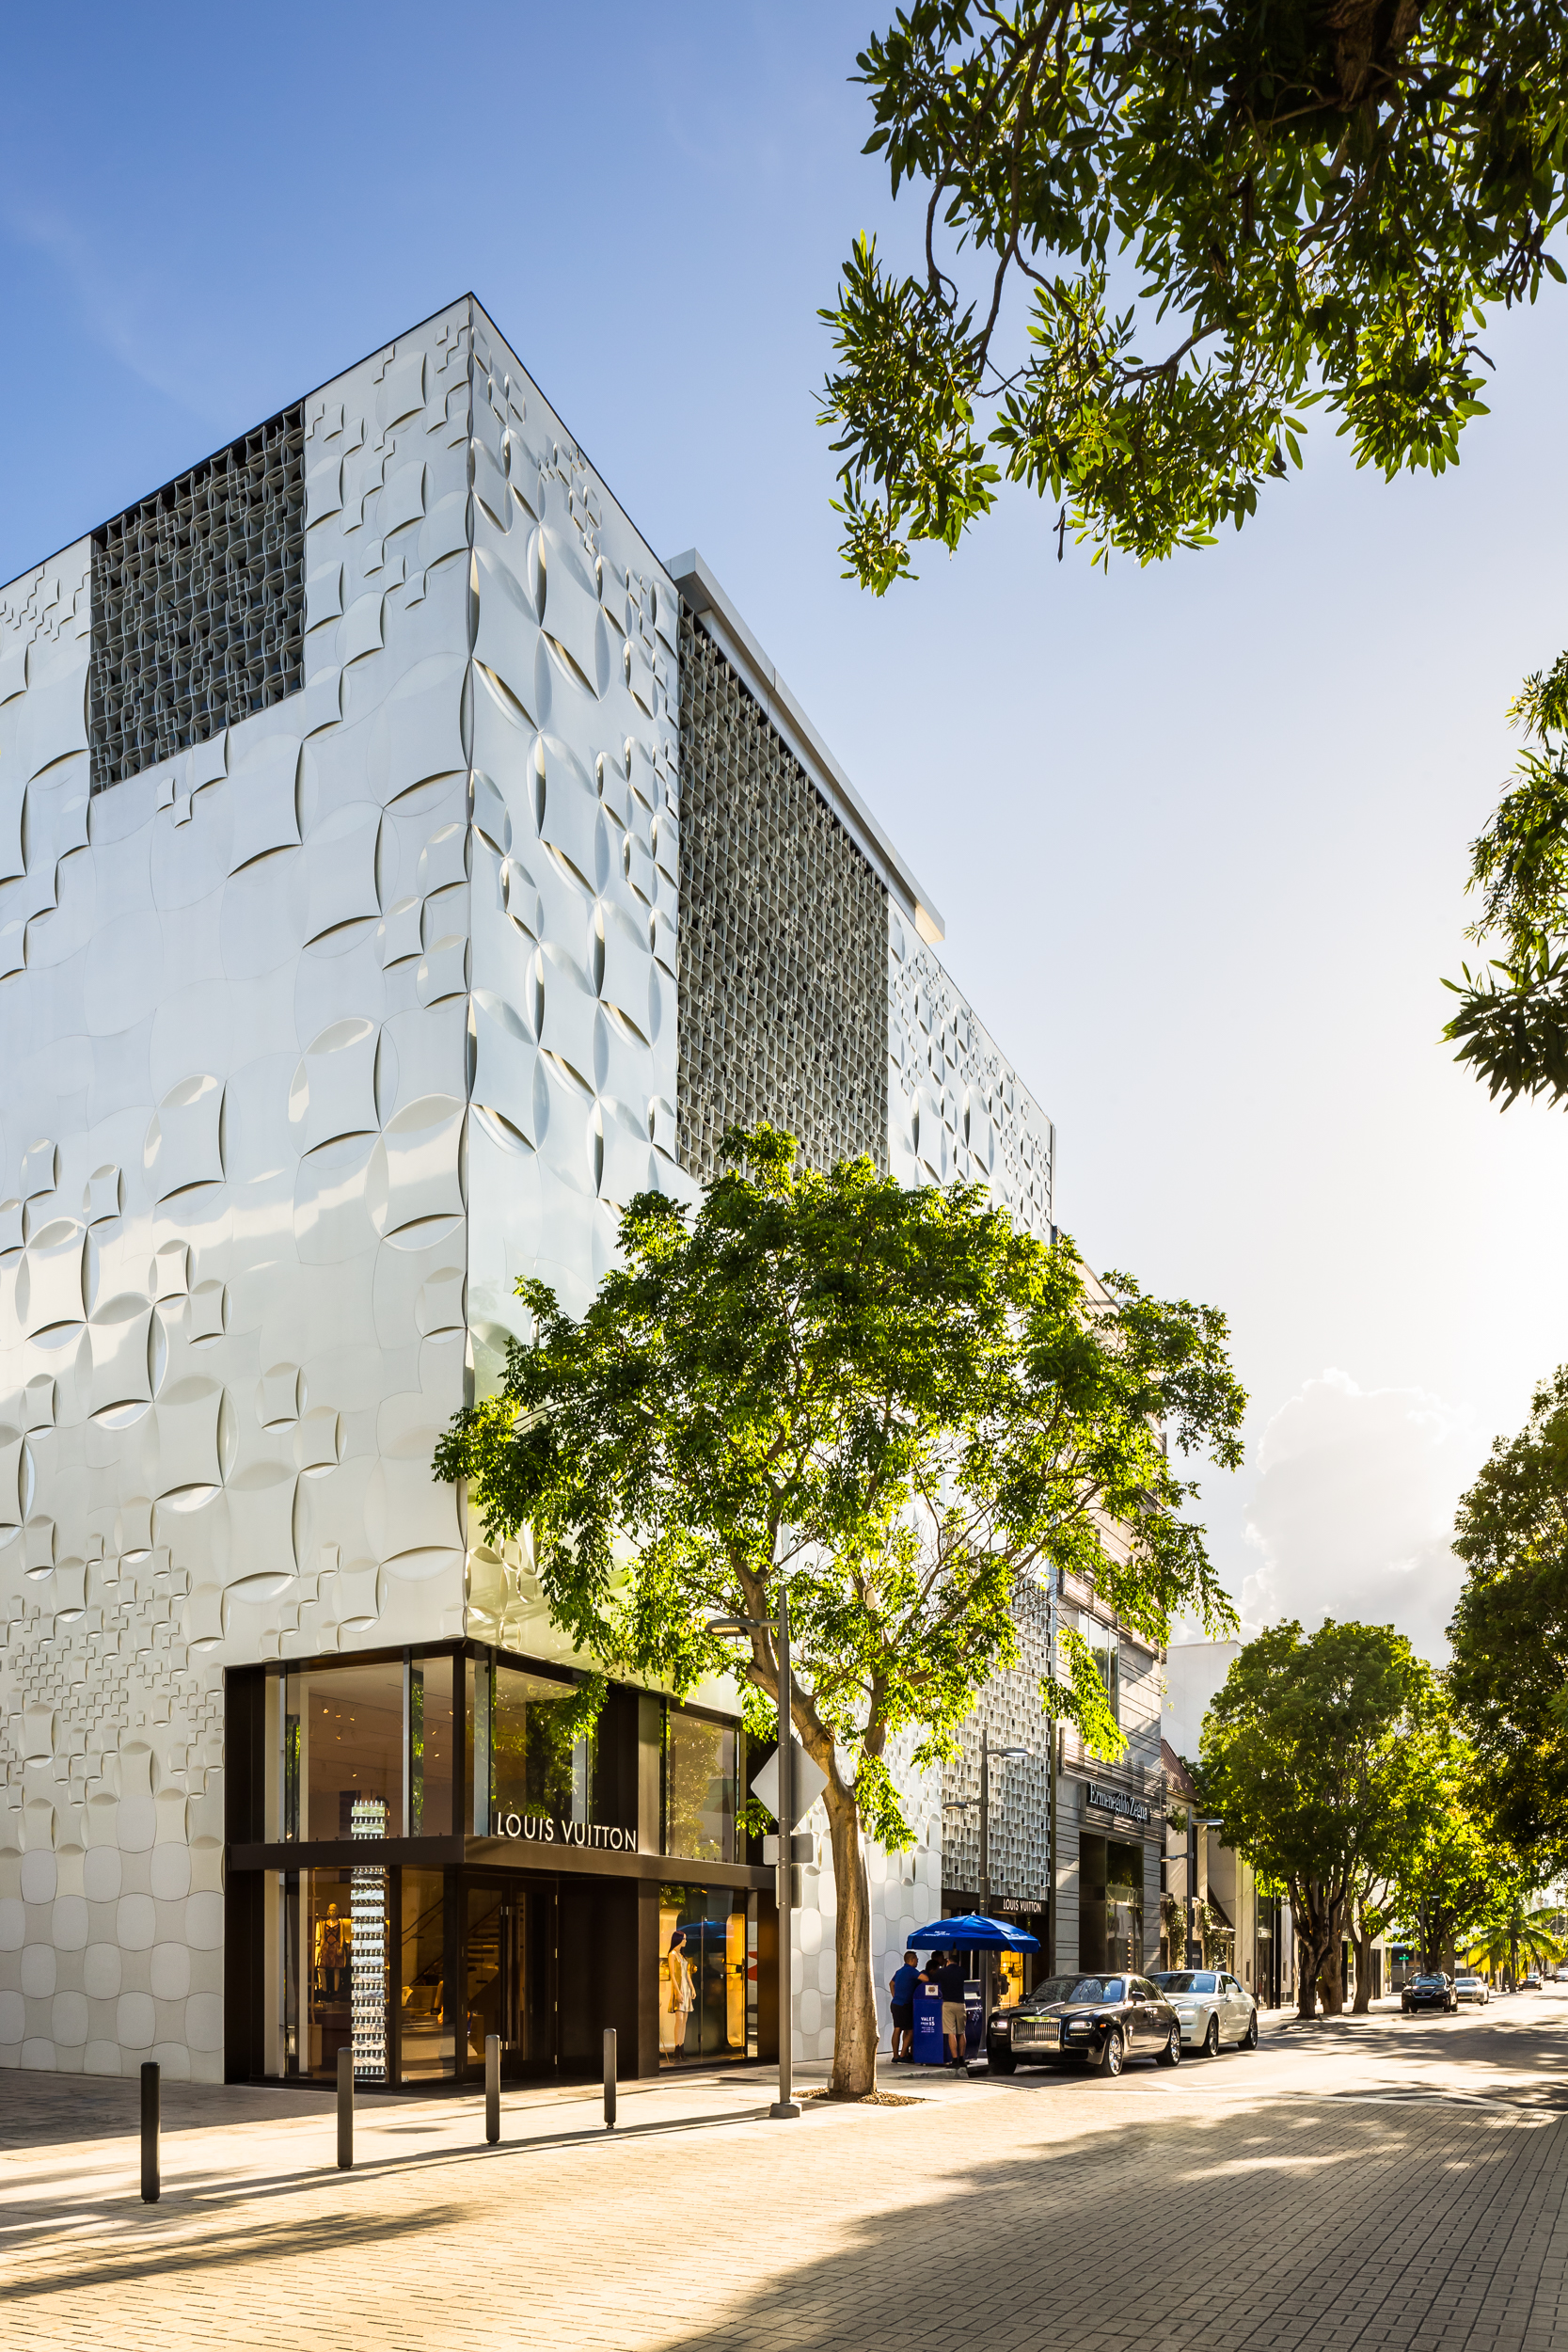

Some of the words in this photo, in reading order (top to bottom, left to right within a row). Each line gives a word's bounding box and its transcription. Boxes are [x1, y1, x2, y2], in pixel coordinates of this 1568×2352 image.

[1089, 1783, 1130, 1816] Ermenegildo
[1129, 1797, 1148, 1823] Zegna
[497, 1811, 554, 1842] LOUIS
[562, 1820, 637, 1851] VUITTON
[1003, 1899, 1020, 1911] LOUIS
[1020, 1900, 1042, 1913] VUITTON
